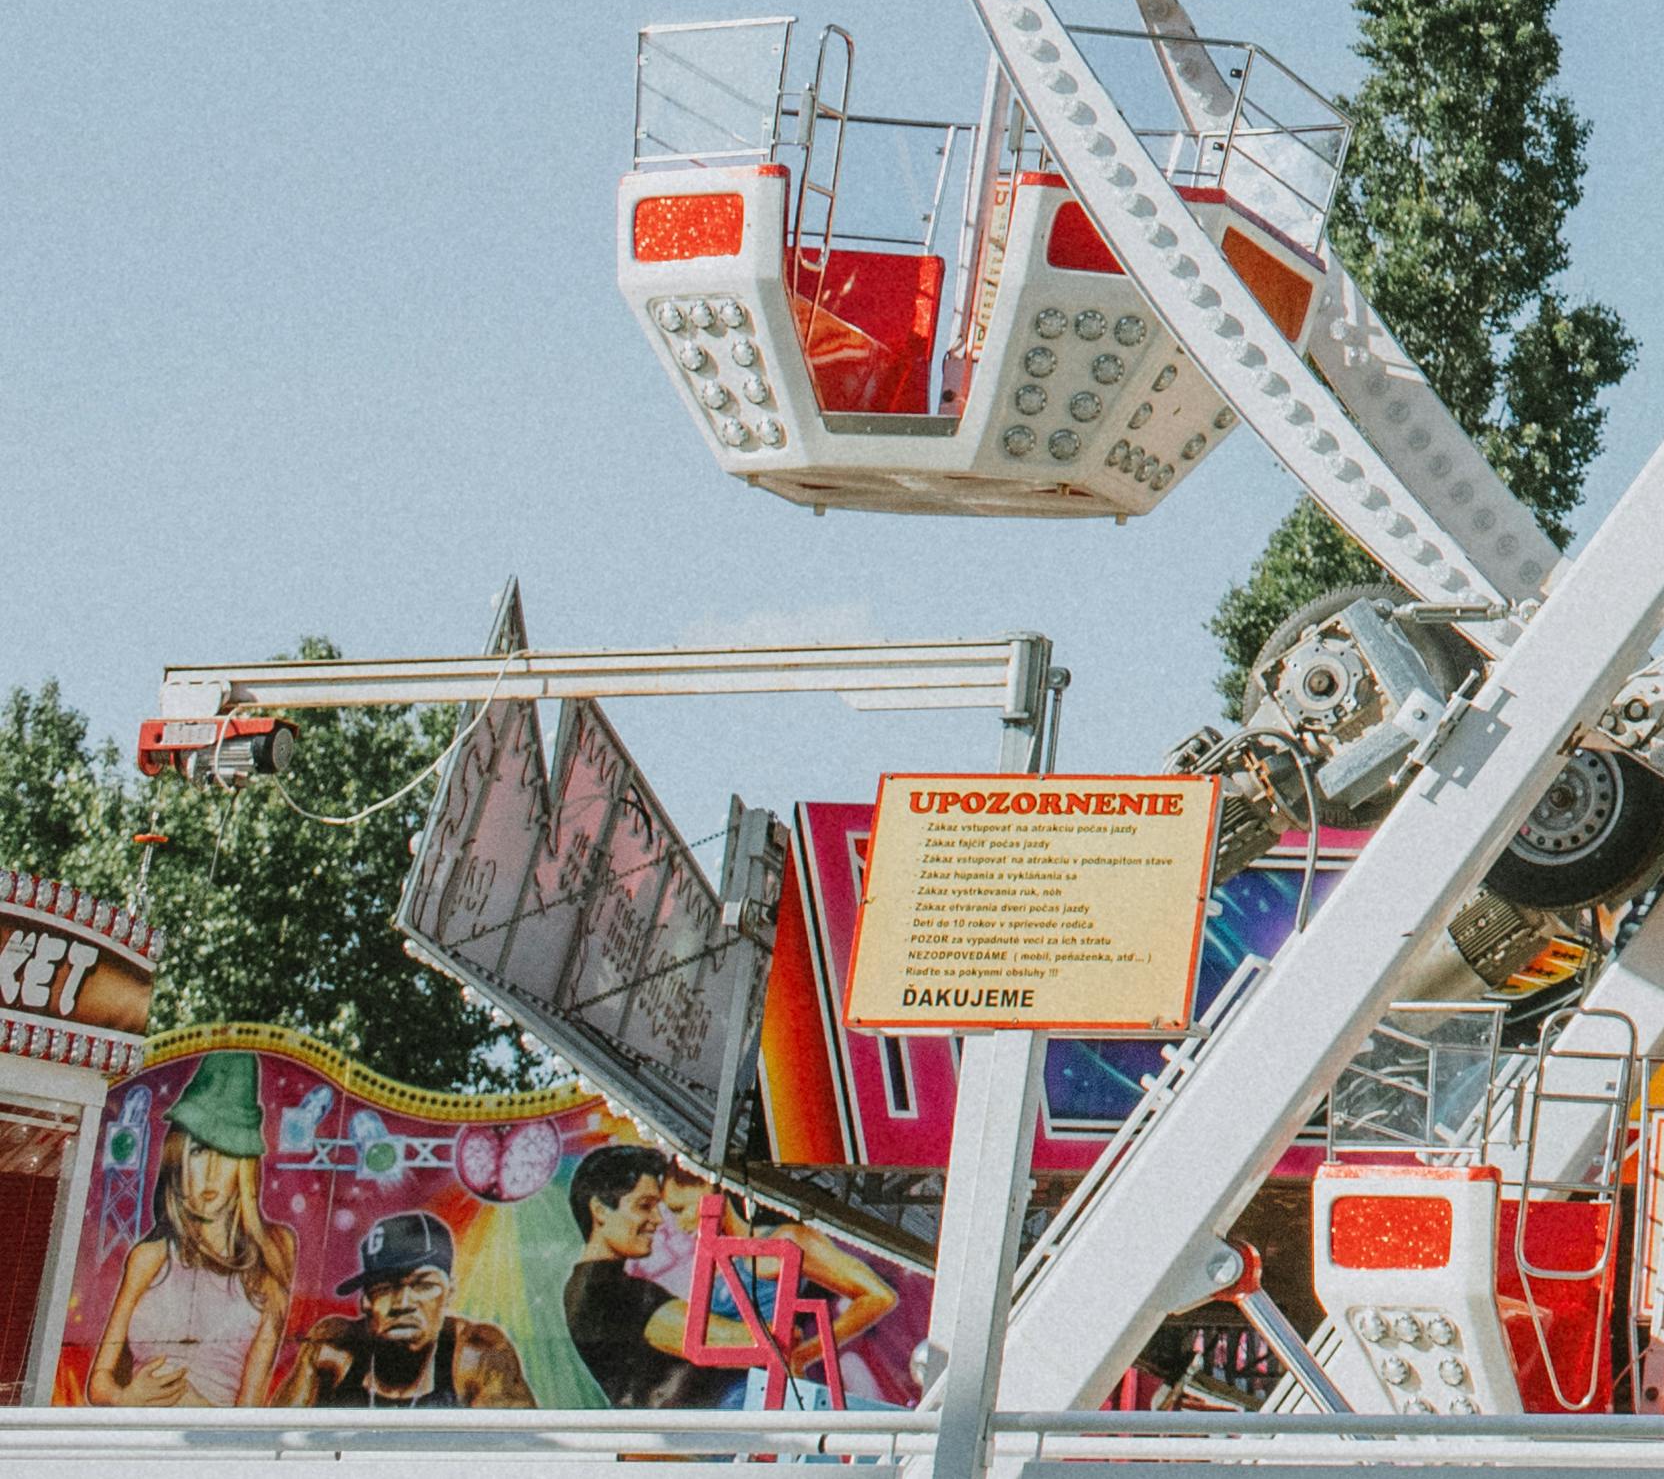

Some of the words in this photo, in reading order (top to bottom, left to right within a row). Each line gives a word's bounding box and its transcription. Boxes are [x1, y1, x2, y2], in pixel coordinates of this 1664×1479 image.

[909, 791, 1183, 816] UPOZORNENIE
[1031, 824, 1074, 833] atrakciu
[1110, 824, 1138, 836] jazdy
[1023, 839, 1051, 851] jazdy
[1011, 857, 1024, 865] na
[1027, 855, 1070, 865] atrakciu
[1145, 856, 1173, 866] stave
[998, 873, 1004, 881] a
[1066, 873, 1078, 881] sa
[1062, 903, 1090, 915] jazdy
[936, 918, 950, 928] do
[953, 918, 965, 928] 10
[968, 918, 996, 928] rokov
[911, 934, 949, 944] POZOR
[952, 936, 963, 944] za
[1047, 937, 1059, 945] za
[1062, 935, 1077, 945] ich
[1080, 935, 1112, 946] stratu
[943, 969, 956, 977] sa
[1005, 968, 1046, 980] obsluhy
[902, 983, 1035, 1008] ĎAKUJEME
